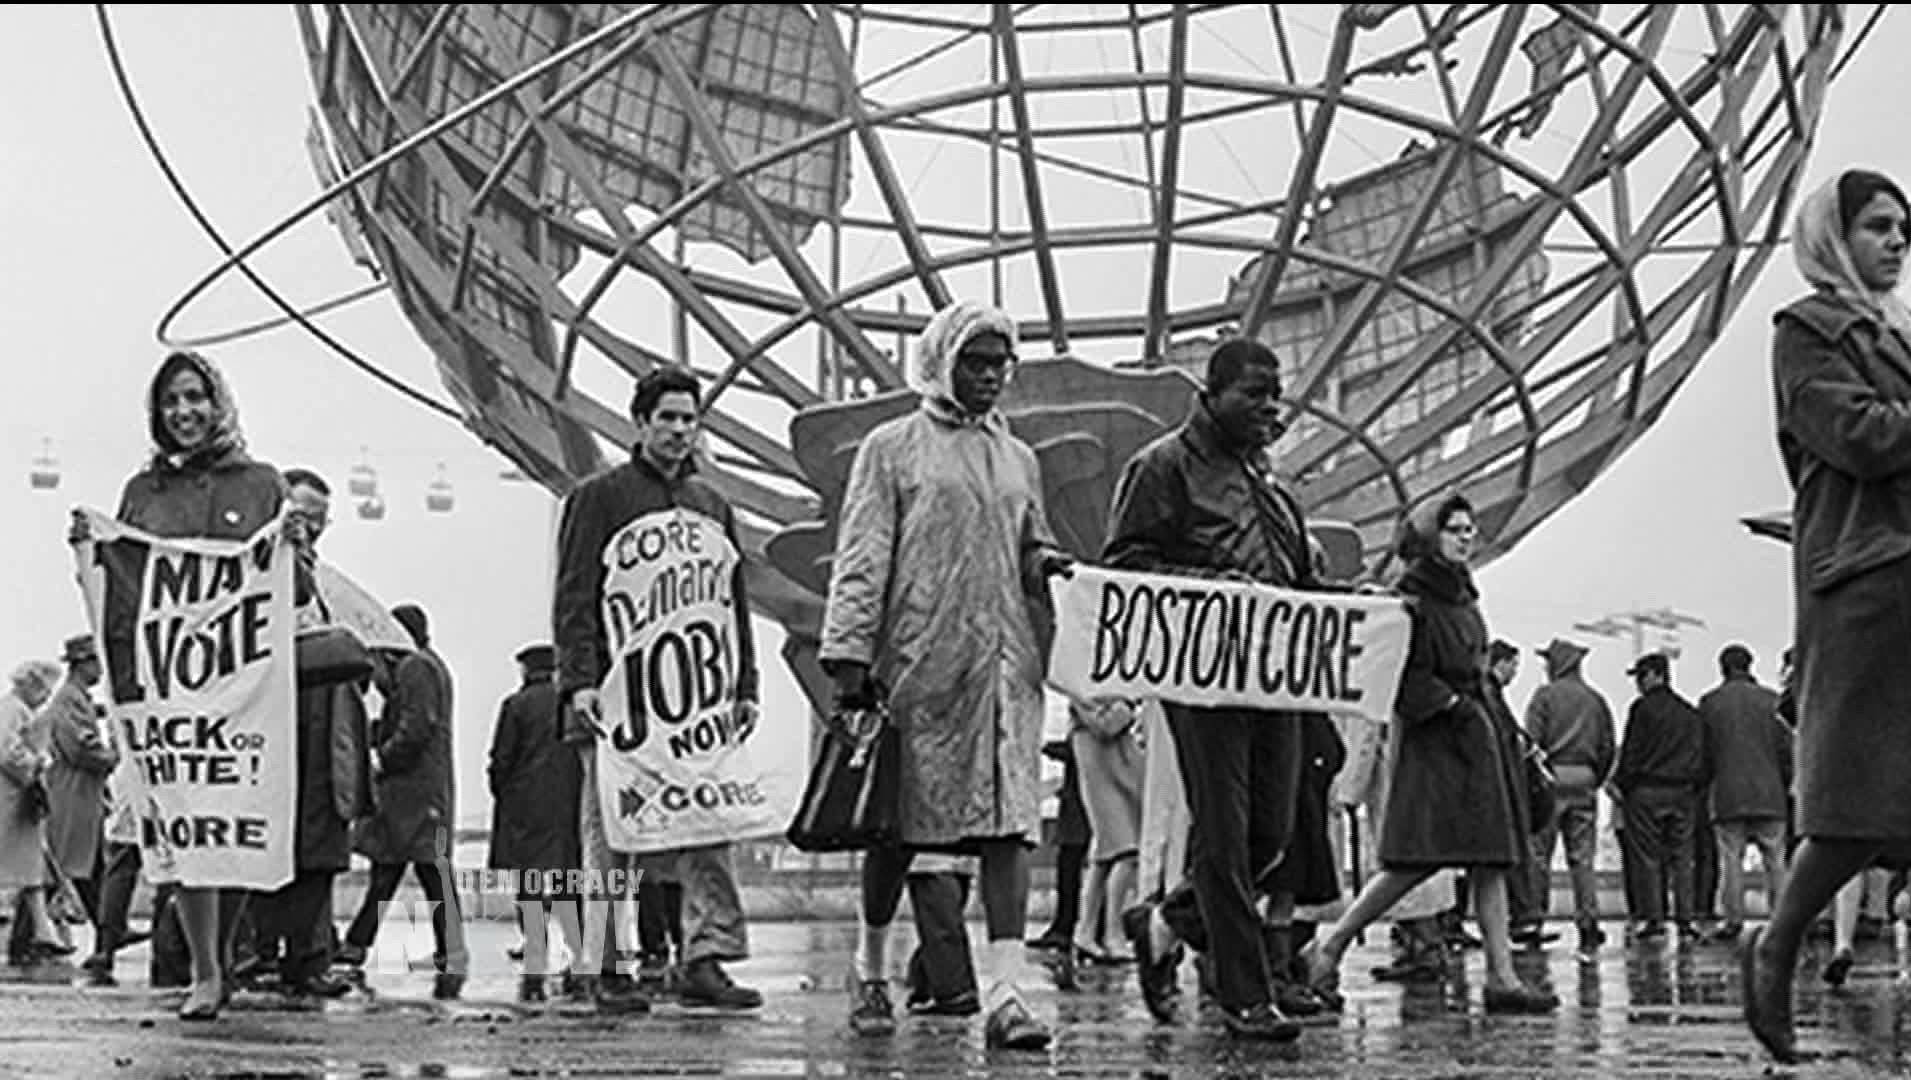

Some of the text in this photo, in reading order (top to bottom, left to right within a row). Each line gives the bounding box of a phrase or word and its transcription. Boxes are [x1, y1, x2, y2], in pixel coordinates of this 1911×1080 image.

[615, 520, 702, 571] CORE
[94, 536, 151, 704] I
[145, 592, 272, 699] VOTE
[1090, 580, 1367, 702] BOSTON CORE
[121, 716, 229, 751] LACK
[136, 753, 260, 786] HITE!
[661, 782, 766, 812] CORE
